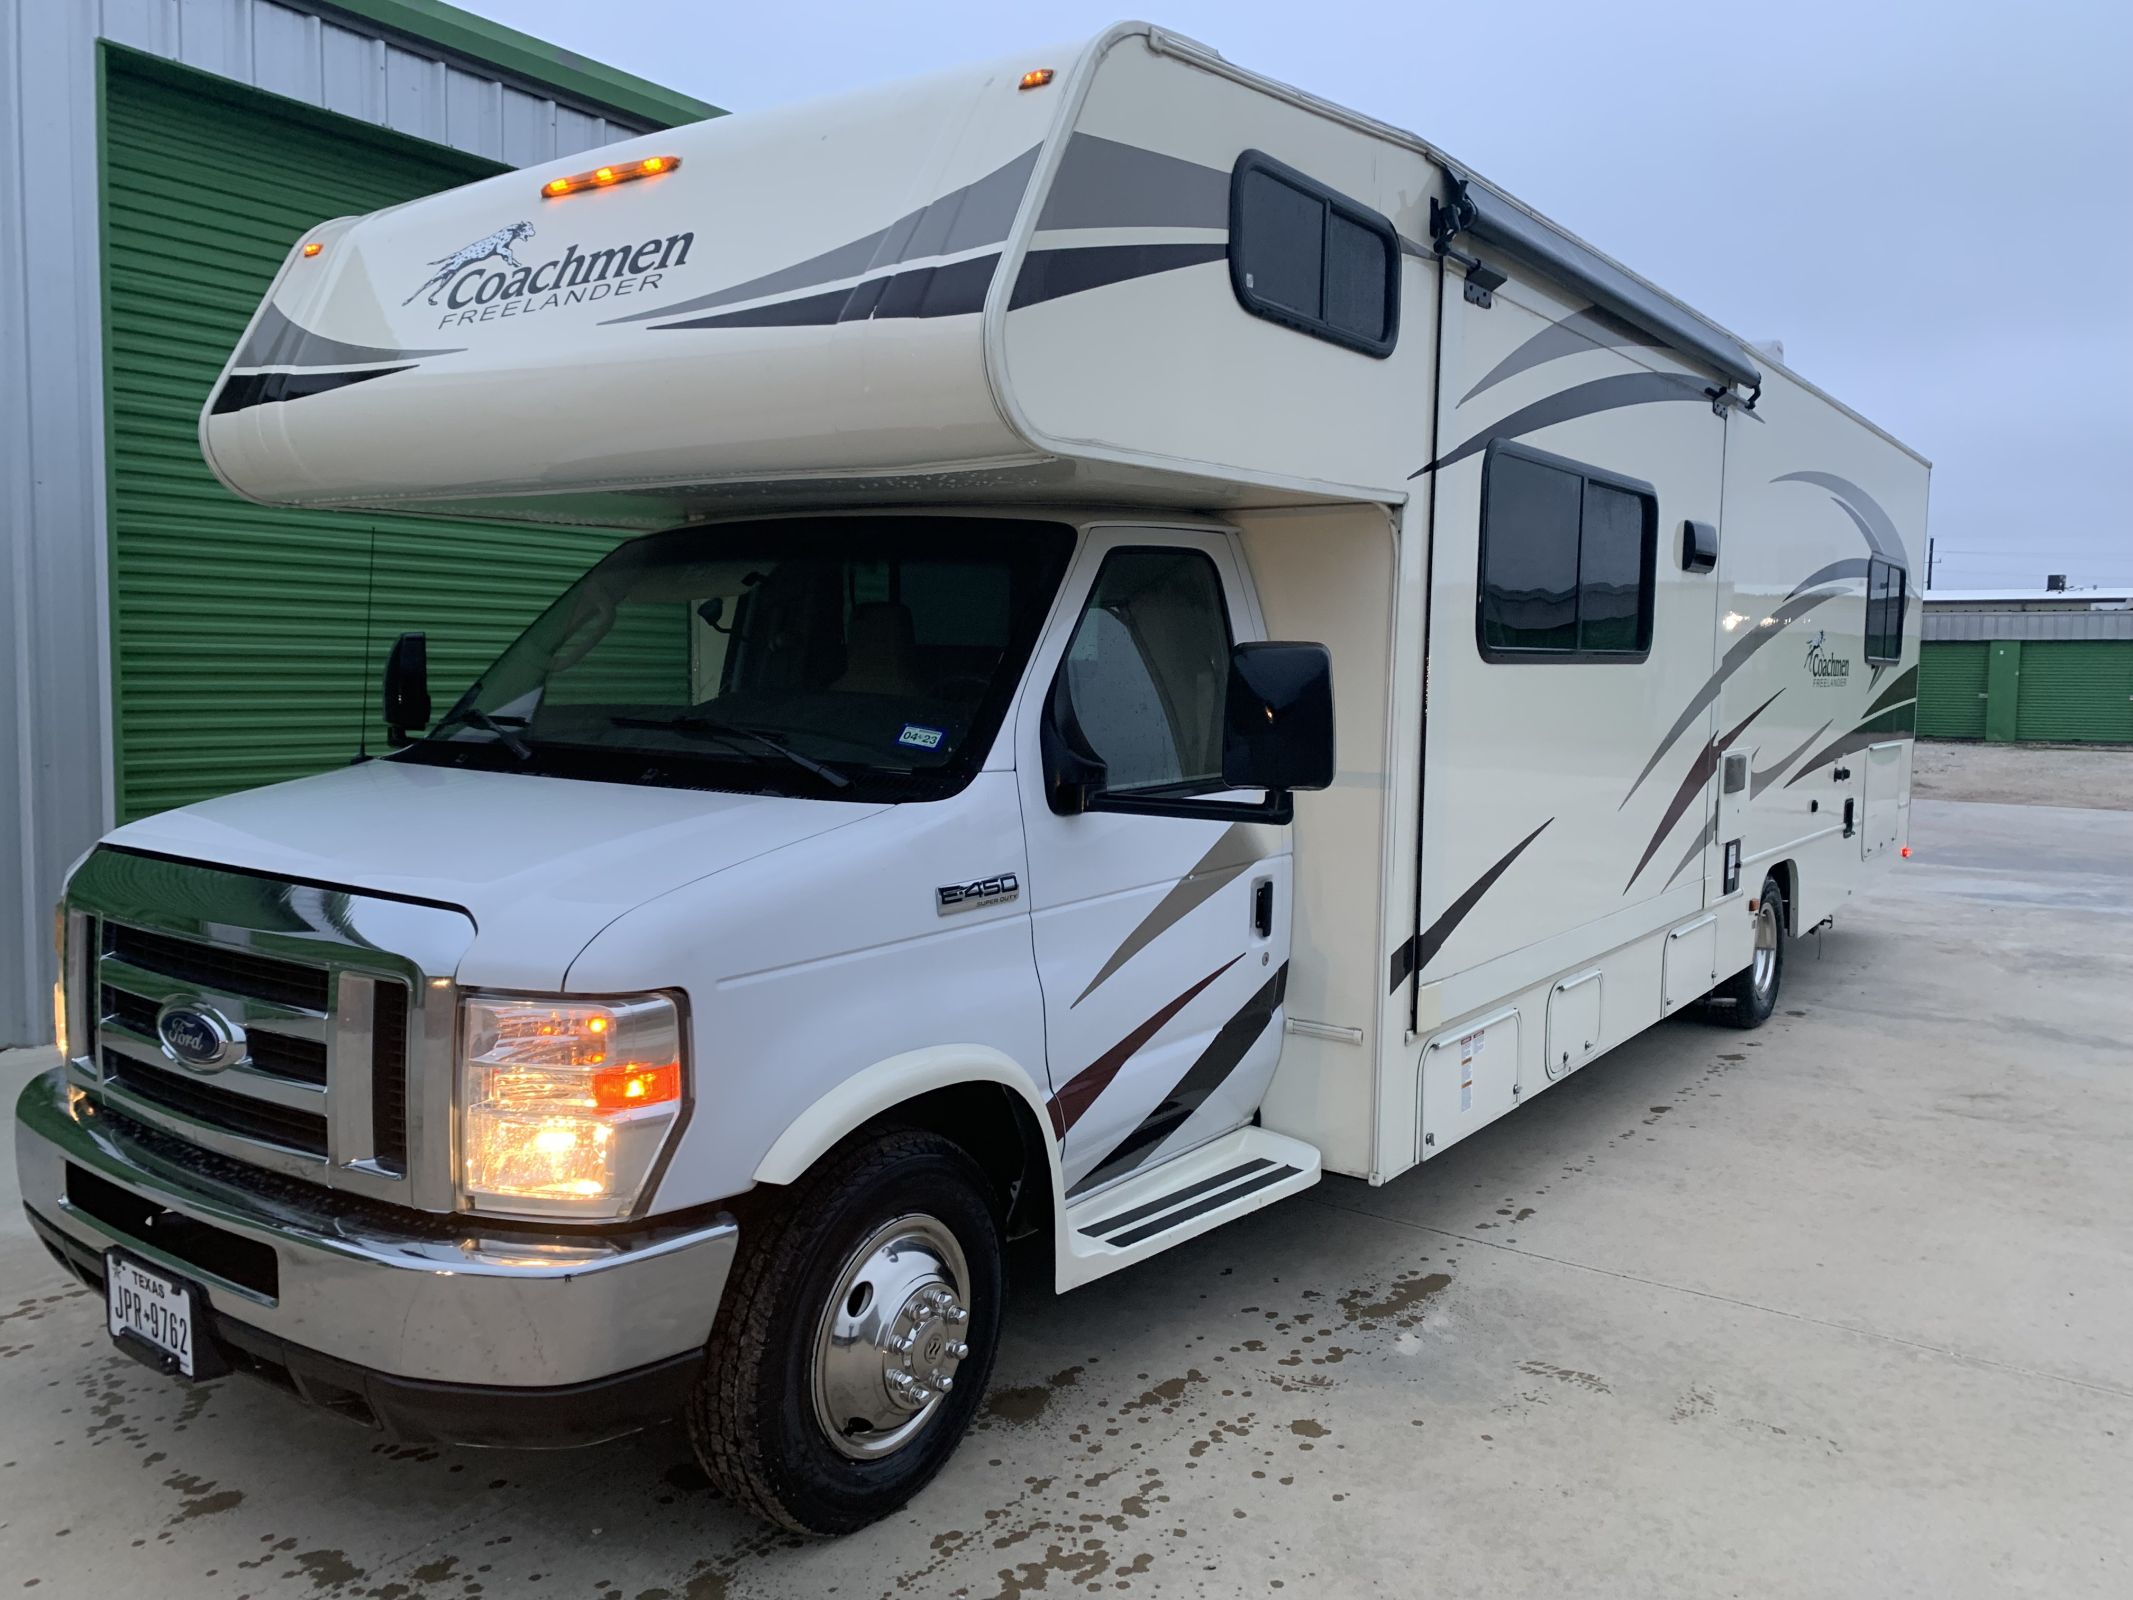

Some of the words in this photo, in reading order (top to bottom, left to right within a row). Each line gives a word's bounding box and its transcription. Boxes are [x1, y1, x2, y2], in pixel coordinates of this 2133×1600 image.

[446, 231, 695, 310] Coachmen
[437, 273, 663, 330] FREELANDER
[1812, 652, 1849, 677] Coachmen
[937, 874, 1018, 905] E-450
[976, 898, 999, 908] SUPER
[1000, 894, 1018, 903] DUTY
[168, 1017, 204, 1050] Ford
[132, 1270, 166, 1299] TEXAS
